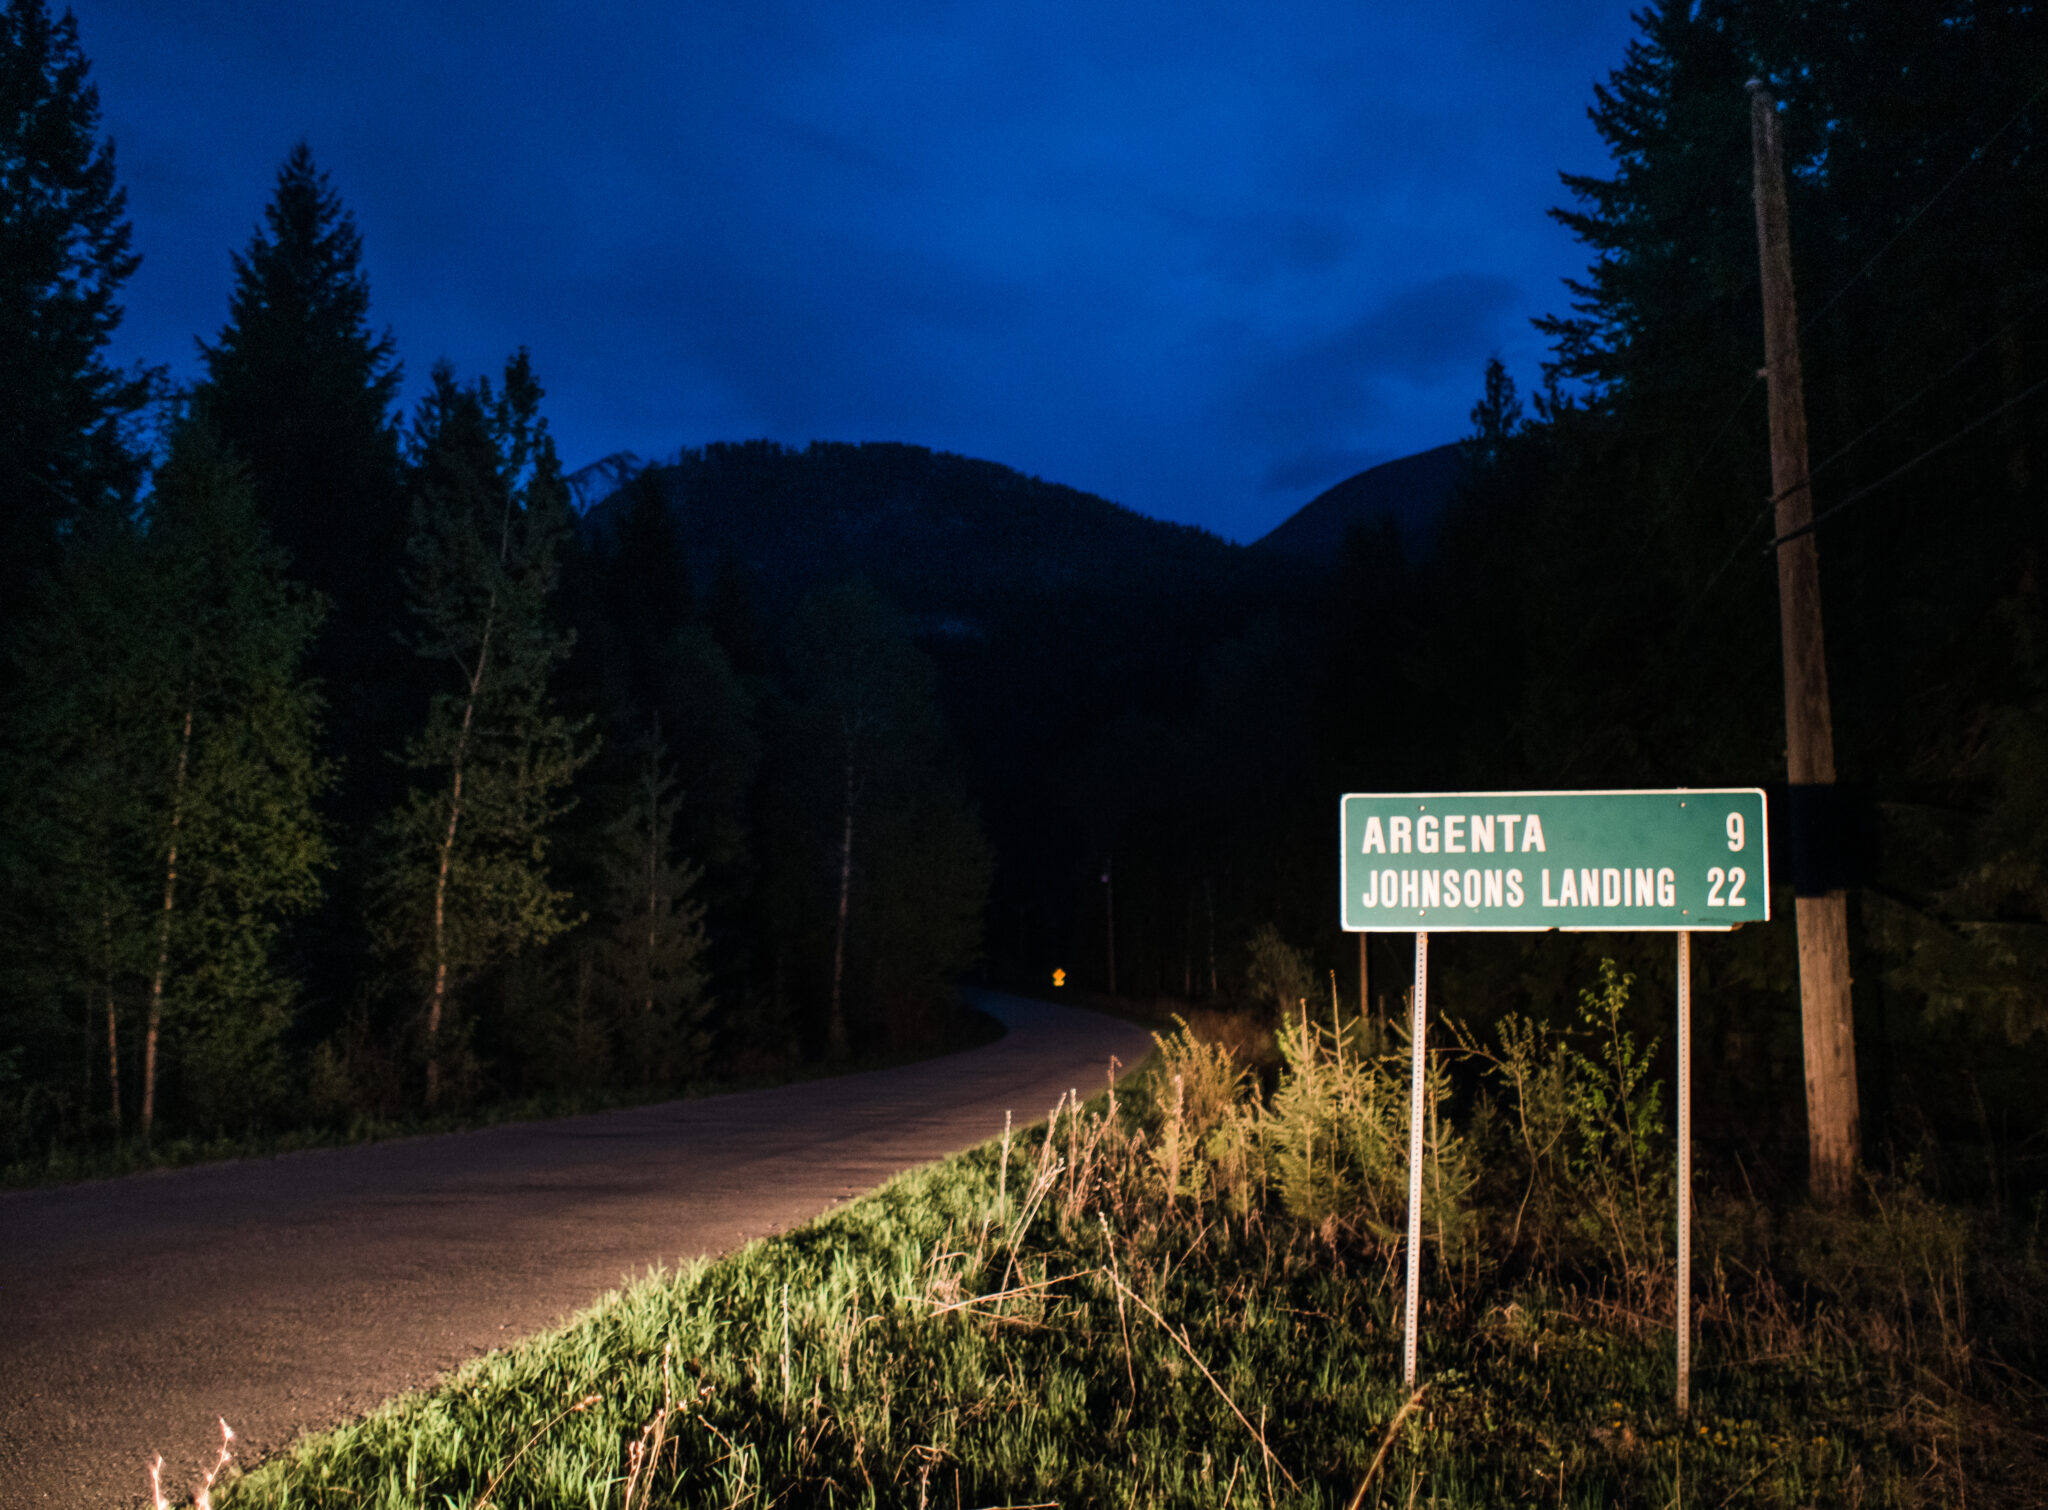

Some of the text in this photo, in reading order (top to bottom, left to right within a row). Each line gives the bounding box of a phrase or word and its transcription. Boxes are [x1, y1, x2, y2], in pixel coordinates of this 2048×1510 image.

[1361, 812, 1746, 855] ARGENTA 9
[1362, 867, 1747, 909] JOHNSONS LANDING 22
